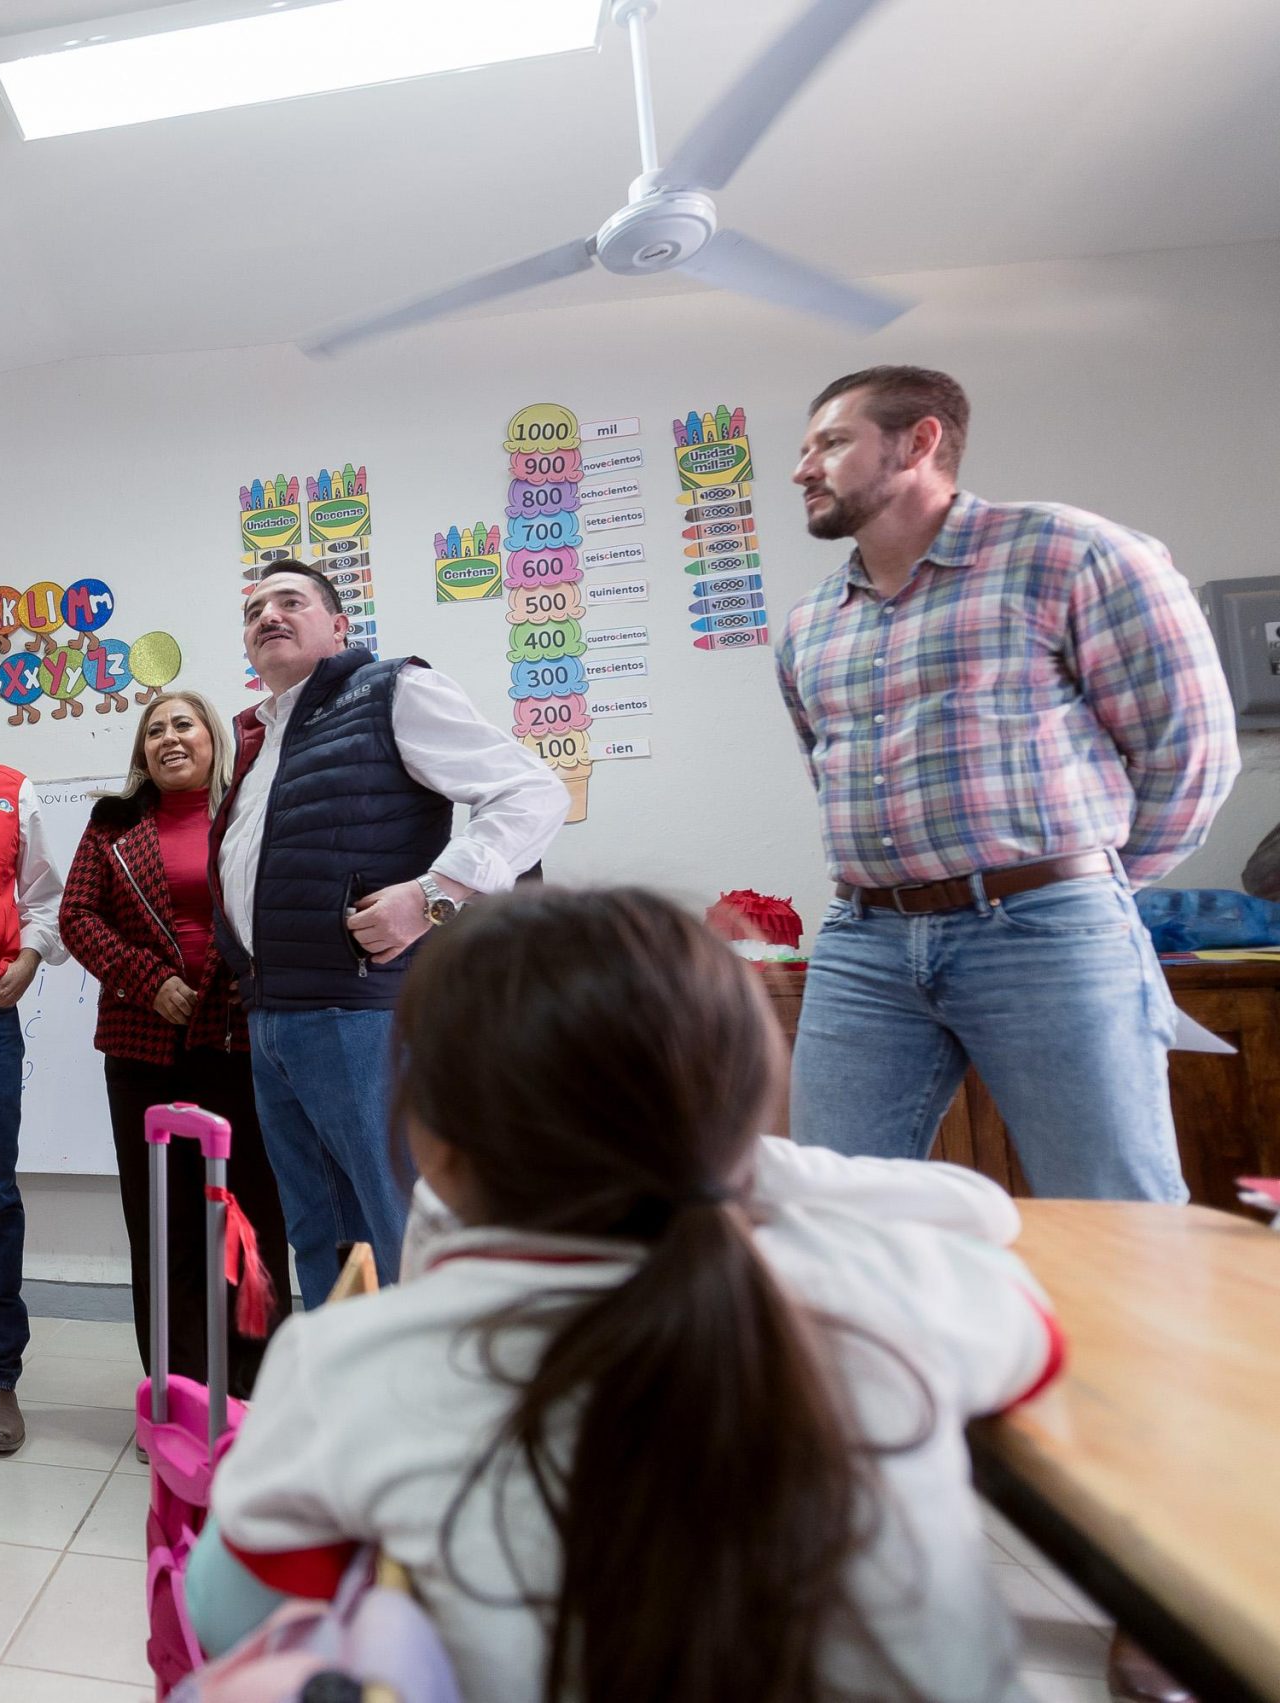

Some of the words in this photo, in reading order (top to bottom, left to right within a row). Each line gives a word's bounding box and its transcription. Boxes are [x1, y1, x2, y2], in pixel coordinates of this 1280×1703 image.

[515, 423, 568, 441] 1000
[597, 424, 618, 436] mil
[690, 446, 735, 461] Unidad
[524, 456, 565, 475] 900
[583, 454, 641, 471] novecientos
[694, 460, 734, 472] millar
[522, 488, 562, 508] 800
[581, 484, 638, 499] ochocientos
[703, 489, 732, 499] 1000
[315, 508, 363, 522] Decenas
[586, 511, 643, 526] setecientos
[704, 507, 735, 517] 2000
[246, 516, 296, 530] Unidades
[706, 523, 737, 535] 3000
[521, 522, 563, 541] 700
[336, 540, 350, 551] 10
[708, 540, 739, 551] 4000
[271, 550, 277, 559] 1
[585, 549, 642, 562] seiscientos
[336, 557, 351, 568] 20
[522, 558, 563, 578] 600
[710, 558, 742, 569] 5000
[337, 572, 352, 583] 30
[443, 568, 494, 579] Centena
[589, 585, 645, 598] quinientos
[713, 579, 744, 591] 6000
[67, 586, 113, 626] Mm
[525, 593, 566, 614] 500
[714, 597, 746, 609] 7000
[717, 615, 749, 627] 8000
[524, 630, 566, 650] 400
[587, 631, 647, 643] cuatrocientos
[719, 633, 751, 644] 9000
[586, 662, 644, 675] trescientos
[527, 666, 568, 688] 300
[591, 700, 648, 713] doscientos
[530, 705, 572, 726] 200
[536, 738, 576, 759] 100
[605, 743, 633, 755] cien
